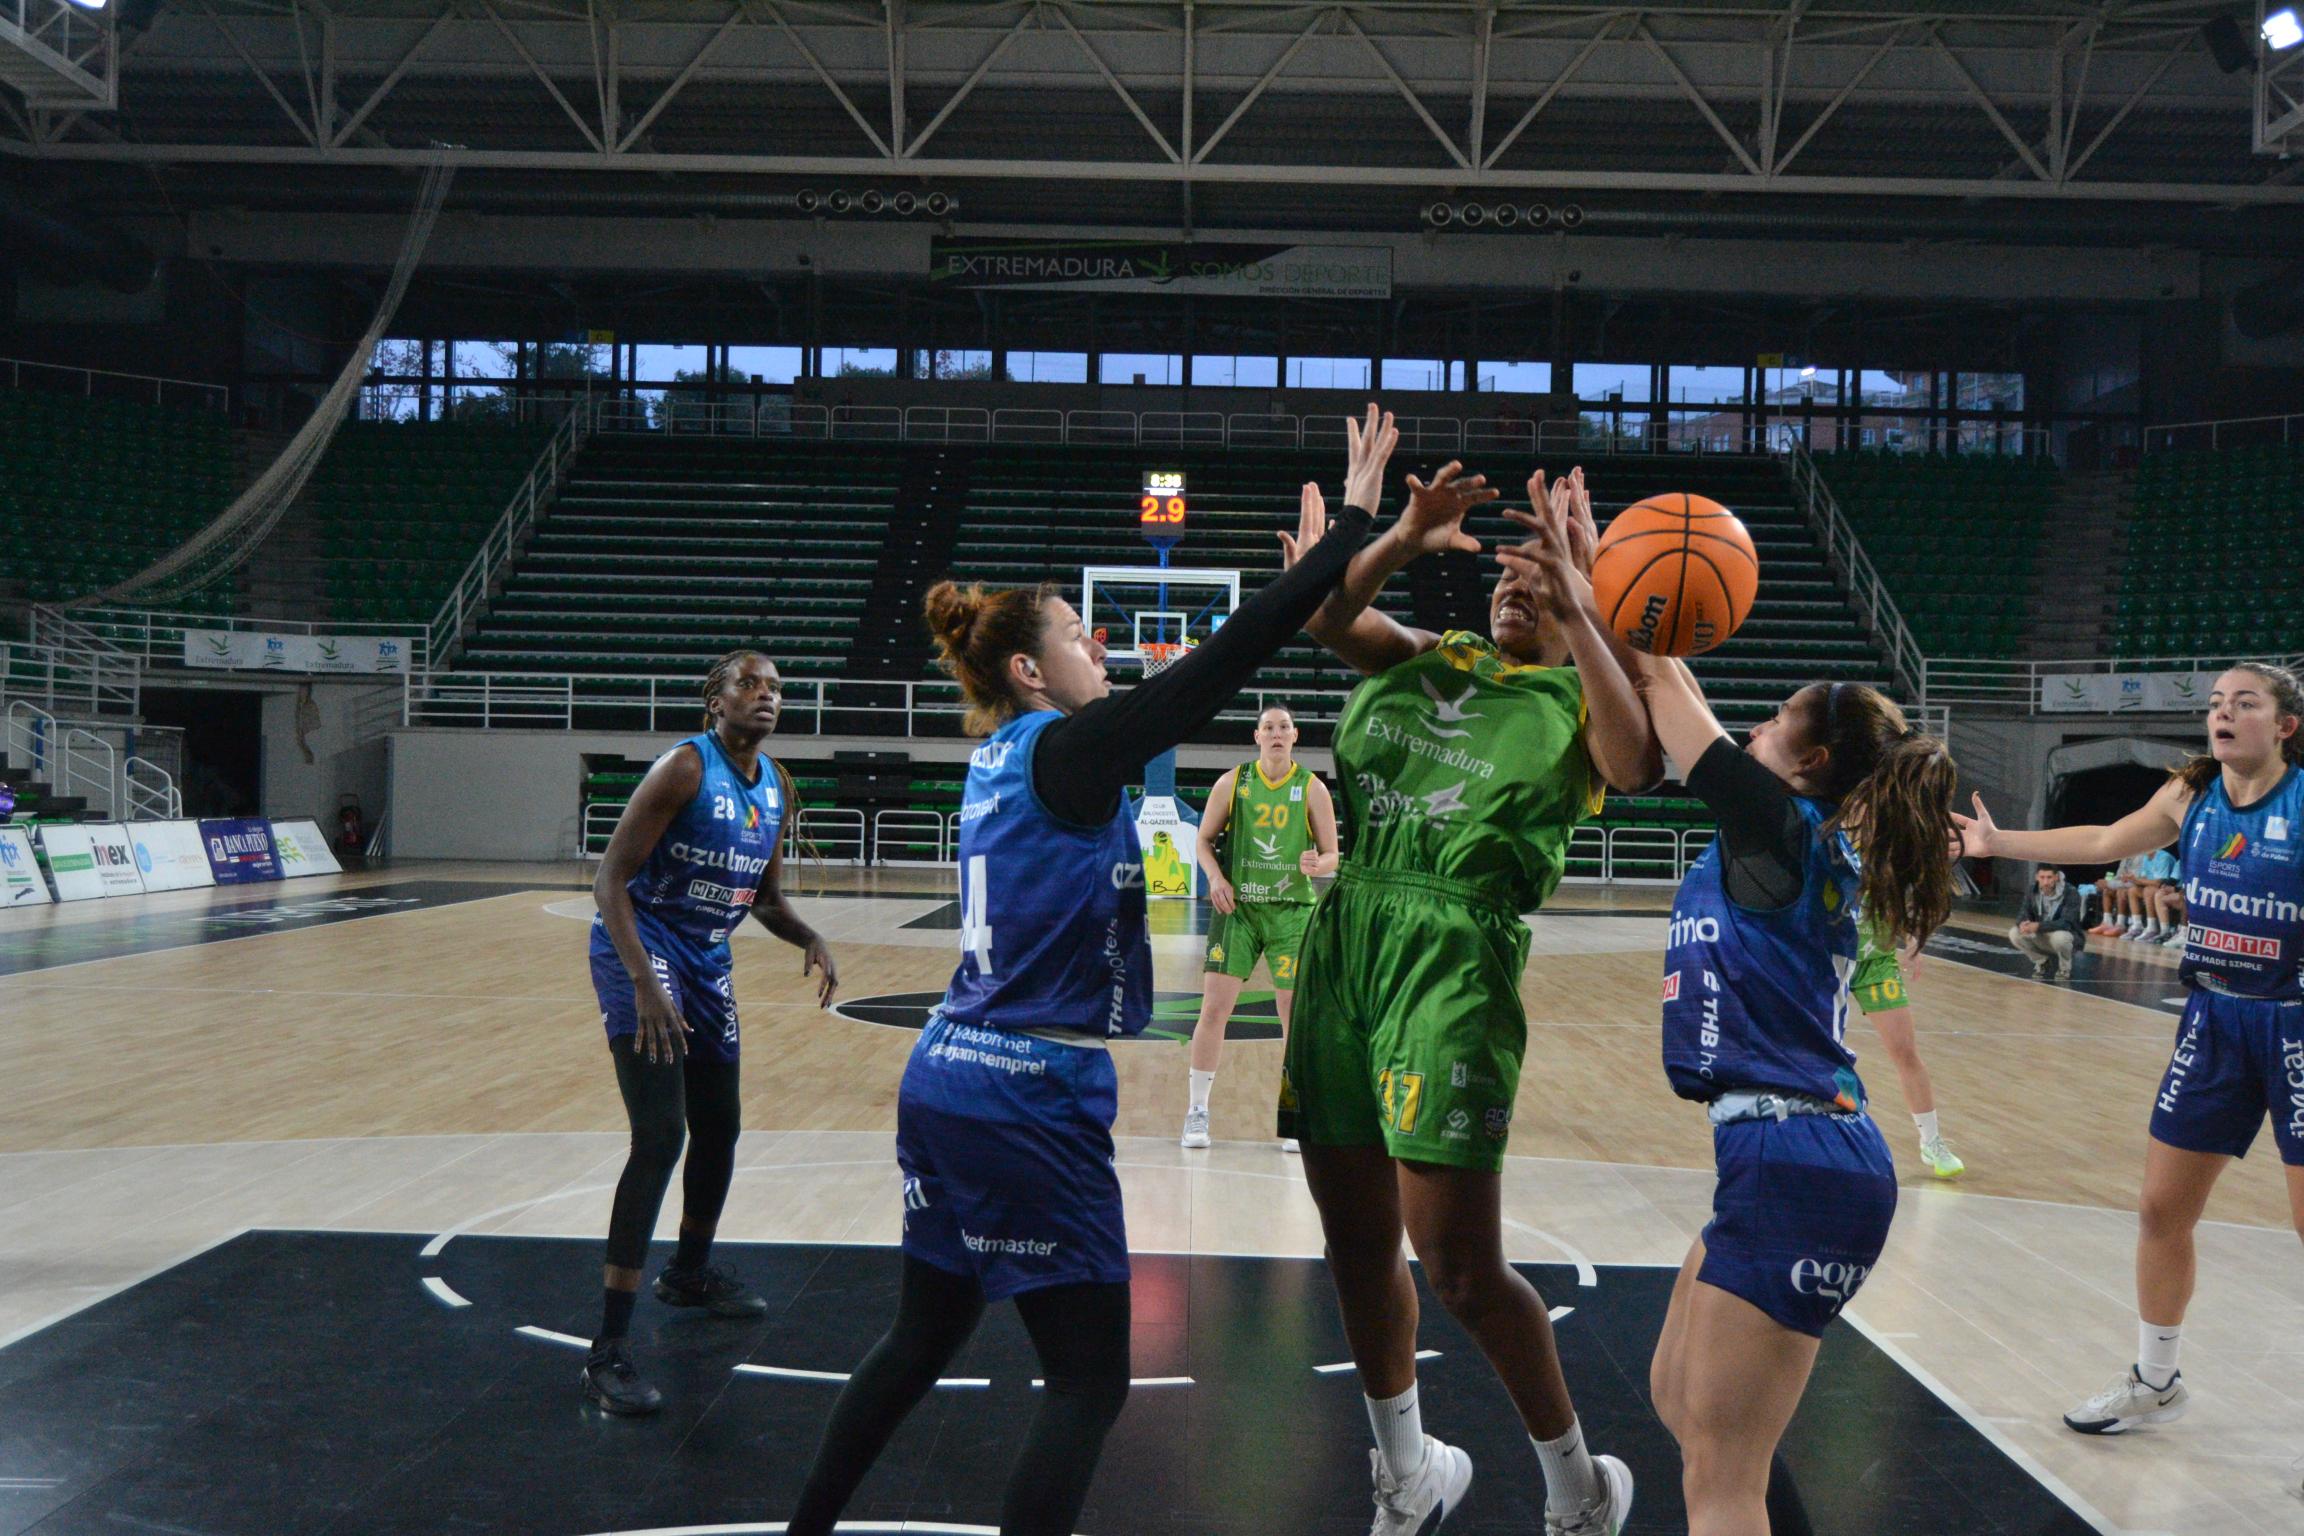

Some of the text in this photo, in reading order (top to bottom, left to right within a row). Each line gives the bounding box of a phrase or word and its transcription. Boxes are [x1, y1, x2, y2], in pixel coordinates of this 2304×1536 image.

[949, 255, 1388, 285] EXTREMADURA SOMOS DEPORTE
[1141, 496, 1185, 523] 2.9
[1365, 715, 1495, 780] Extremadura
[713, 795, 736, 820] 28
[1253, 802, 1290, 829] 20
[2192, 822, 2206, 848] 7
[1240, 857, 1298, 872] Extremadura
[1240, 881, 1271, 894] alter
[2183, 876, 2304, 922] lmarin
[1103, 917, 1126, 982] hotels
[2202, 954, 2227, 967] MADE
[2228, 959, 2263, 972] SIMPLE
[1108, 984, 1124, 1035] THB
[1700, 997, 1720, 1048] THB
[978, 1050, 1047, 1076] sempre!
